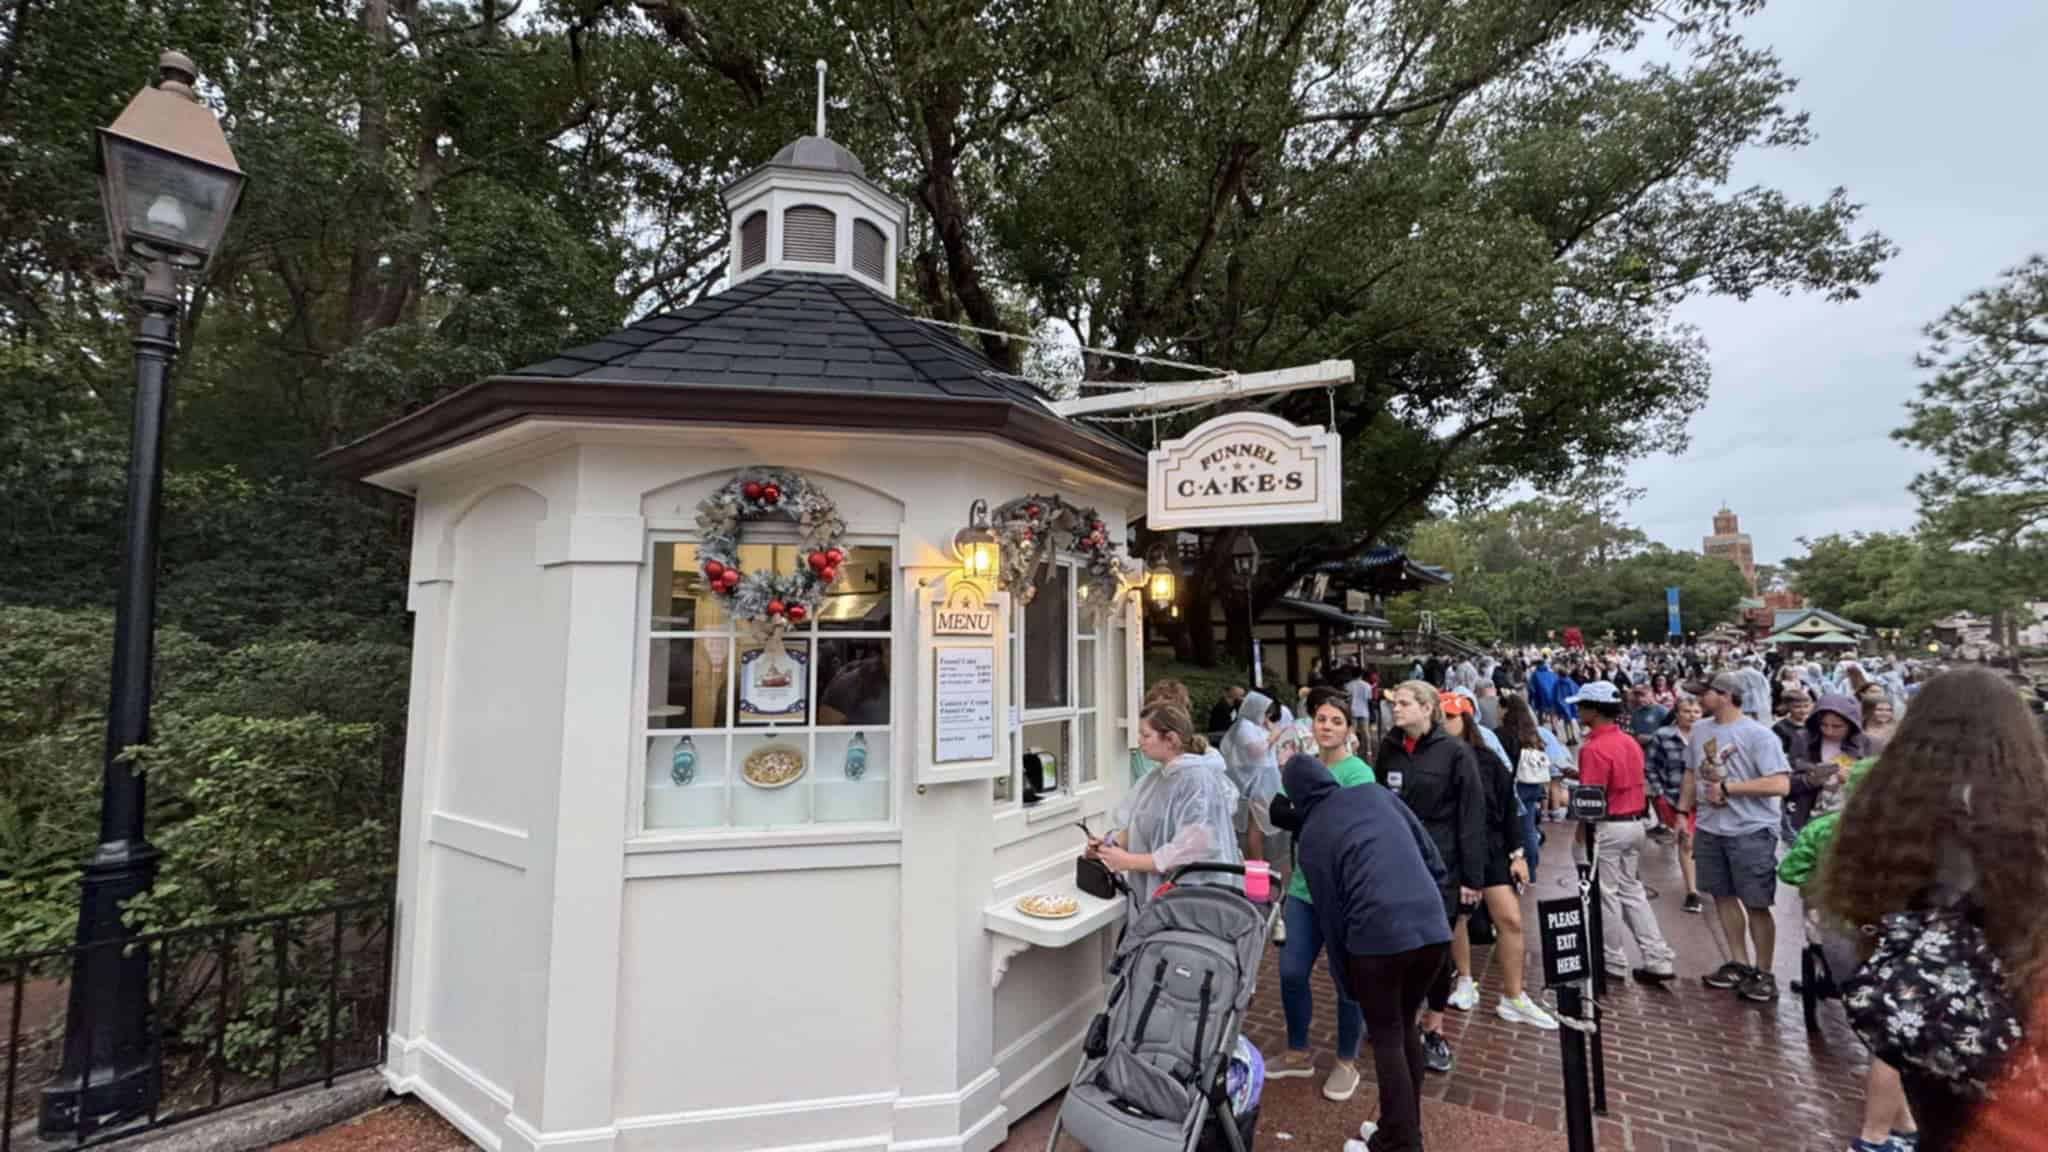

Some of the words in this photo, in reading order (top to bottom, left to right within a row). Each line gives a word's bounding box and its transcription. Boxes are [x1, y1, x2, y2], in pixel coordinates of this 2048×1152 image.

[1200, 443, 1278, 471] FUNNEL
[938, 613, 992, 630] MENU
[1548, 910, 1580, 929] PLEASE
[1556, 933, 1577, 951] EXIT
[1556, 955, 1582, 975] HERE
